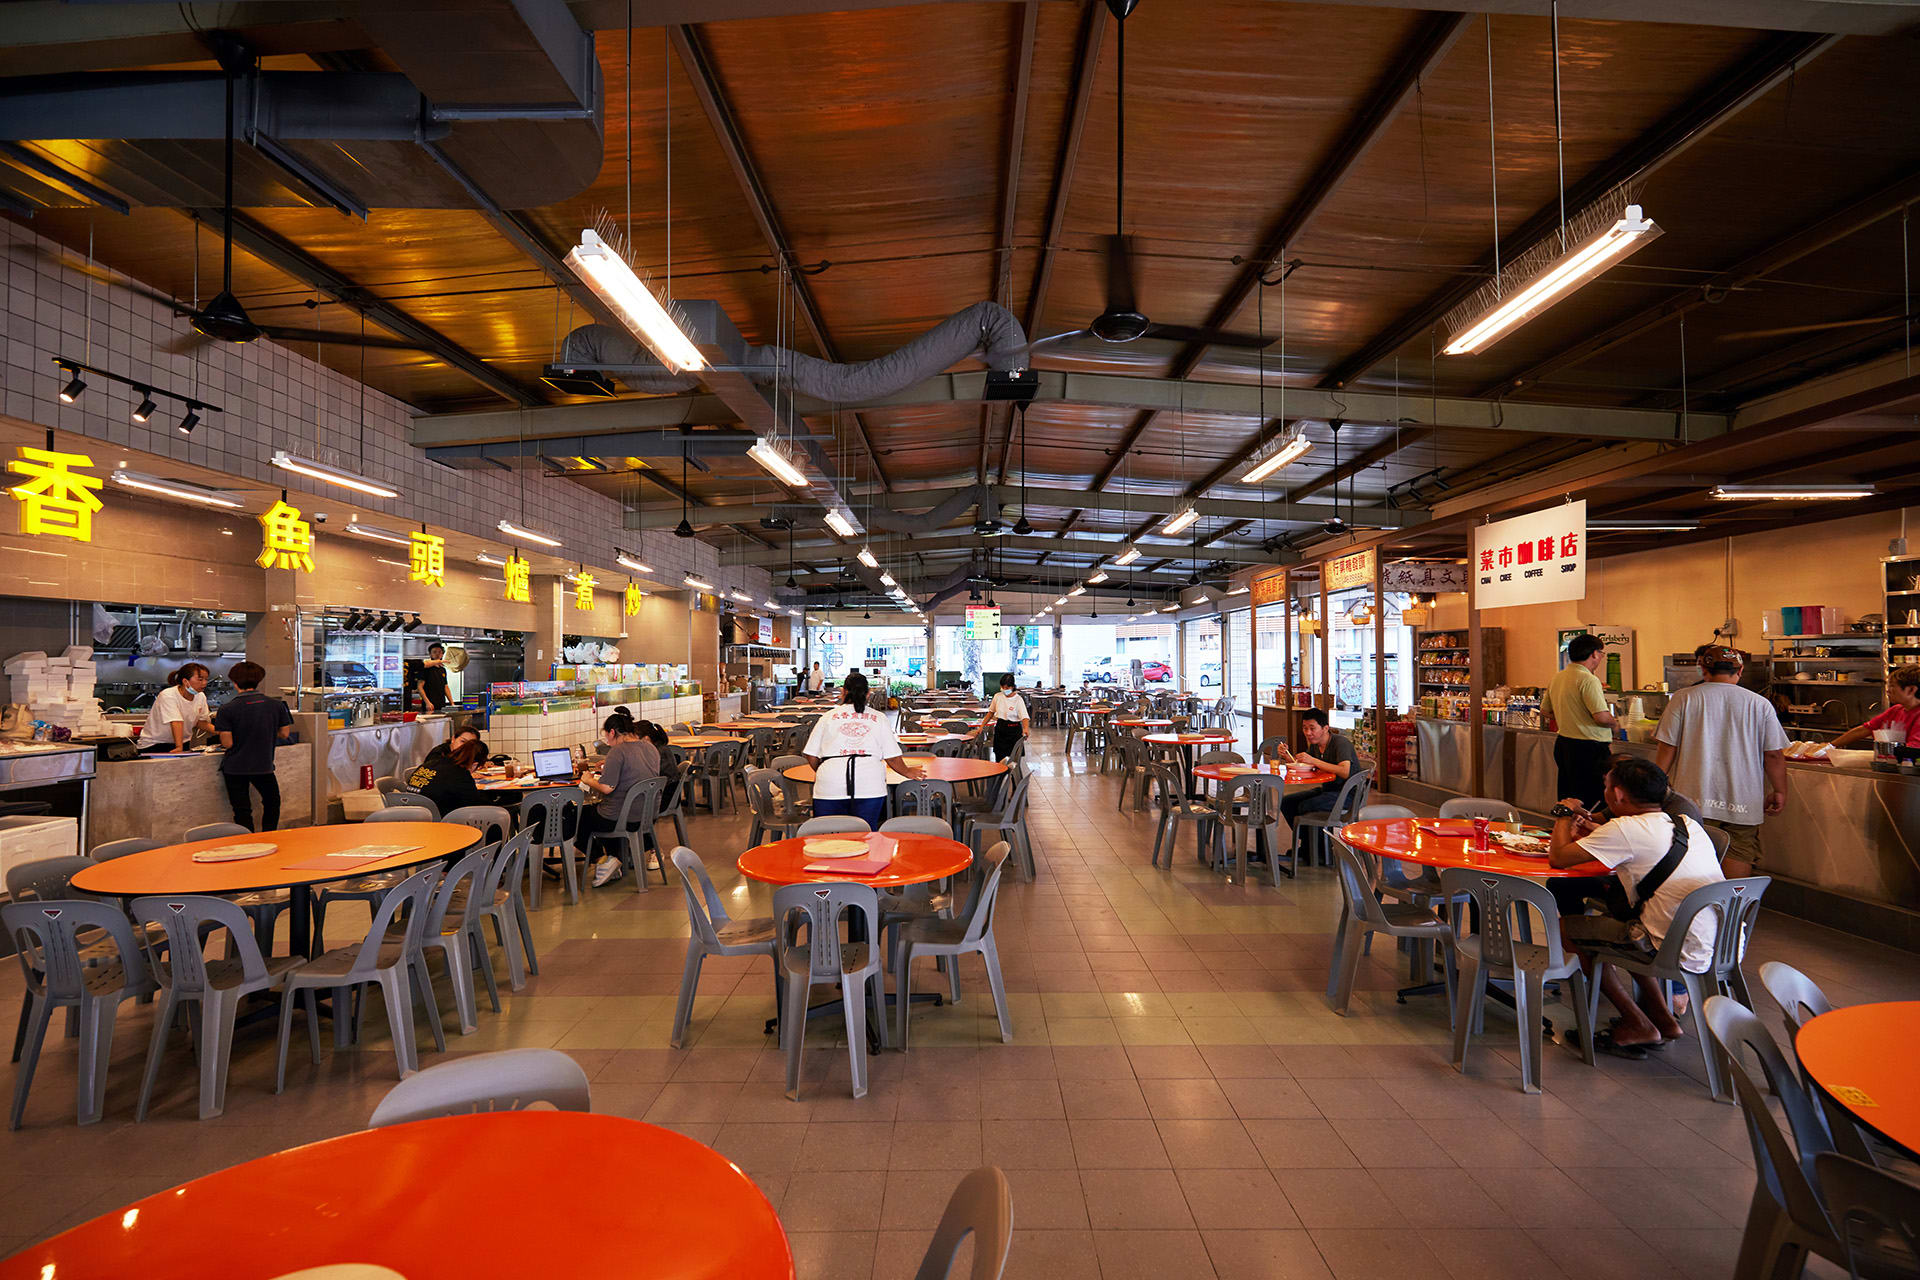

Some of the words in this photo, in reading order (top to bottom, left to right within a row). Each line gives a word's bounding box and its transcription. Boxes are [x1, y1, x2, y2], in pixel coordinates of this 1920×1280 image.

[7, 446, 104, 542] 香
[256, 499, 316, 574] 魚
[409, 531, 446, 588] 頭
[1480, 531, 1578, 572] 菜市咖啡店
[1524, 568, 1543, 578] COFFEE
[1561, 563, 1576, 573] SHOP
